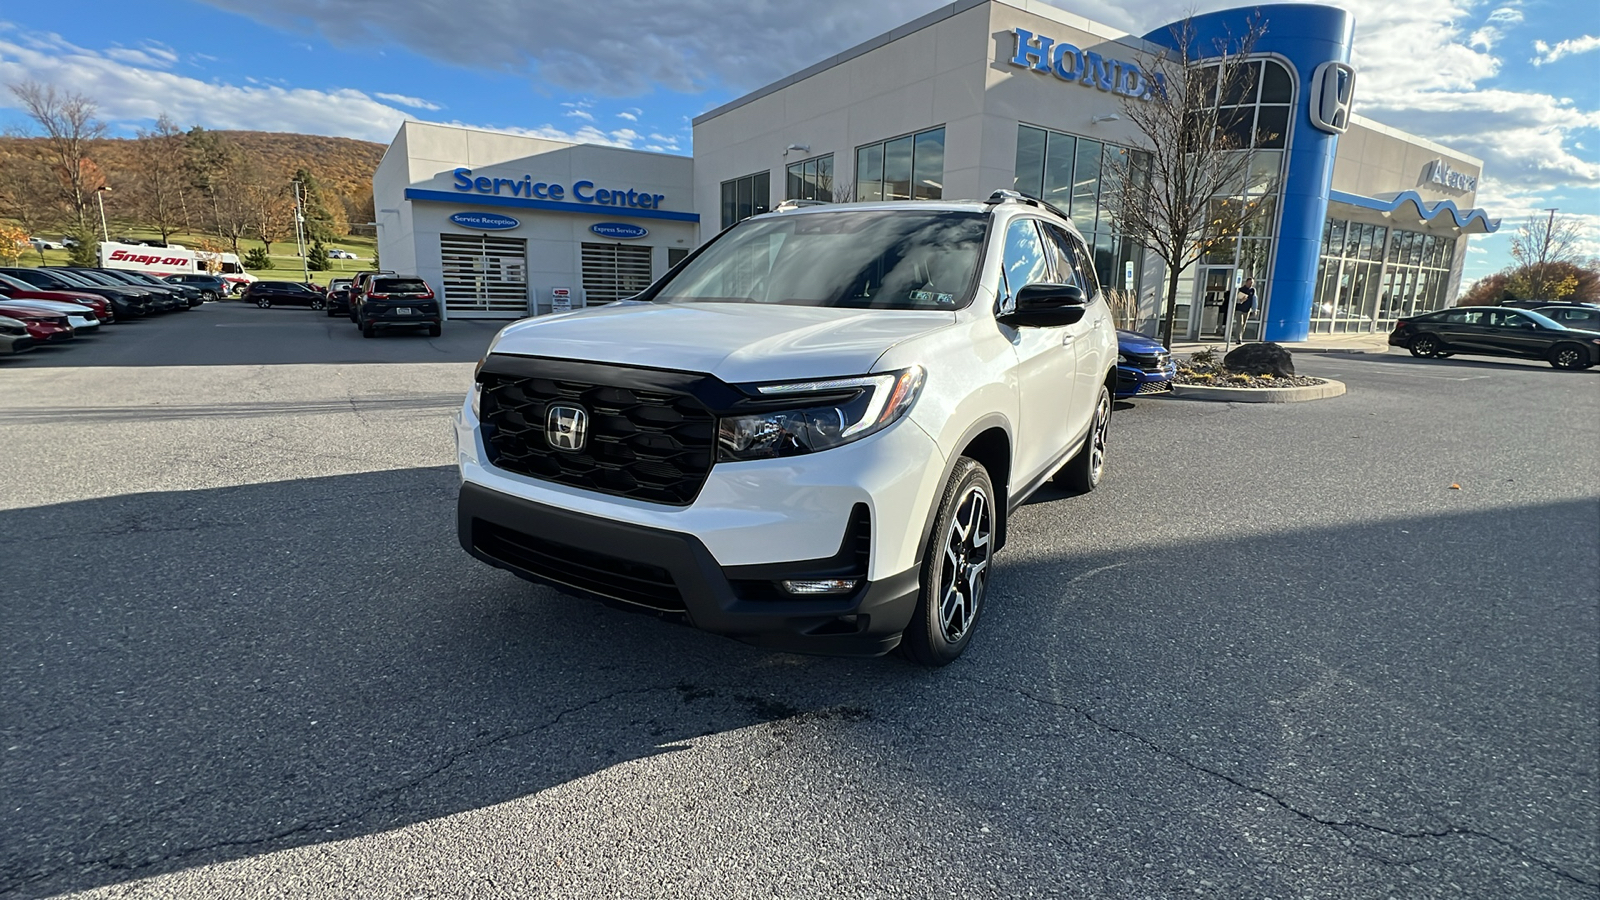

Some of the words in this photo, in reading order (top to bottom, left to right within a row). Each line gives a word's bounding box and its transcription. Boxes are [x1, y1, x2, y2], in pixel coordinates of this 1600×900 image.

[1009, 27, 1168, 102] HONDA
[453, 167, 564, 200] Service
[573, 180, 665, 209] Center
[454, 215, 480, 224] Service
[482, 217, 516, 227] Reception
[593, 225, 615, 234] Express
[616, 227, 637, 235] Service
[108, 250, 188, 266] Snap-on
